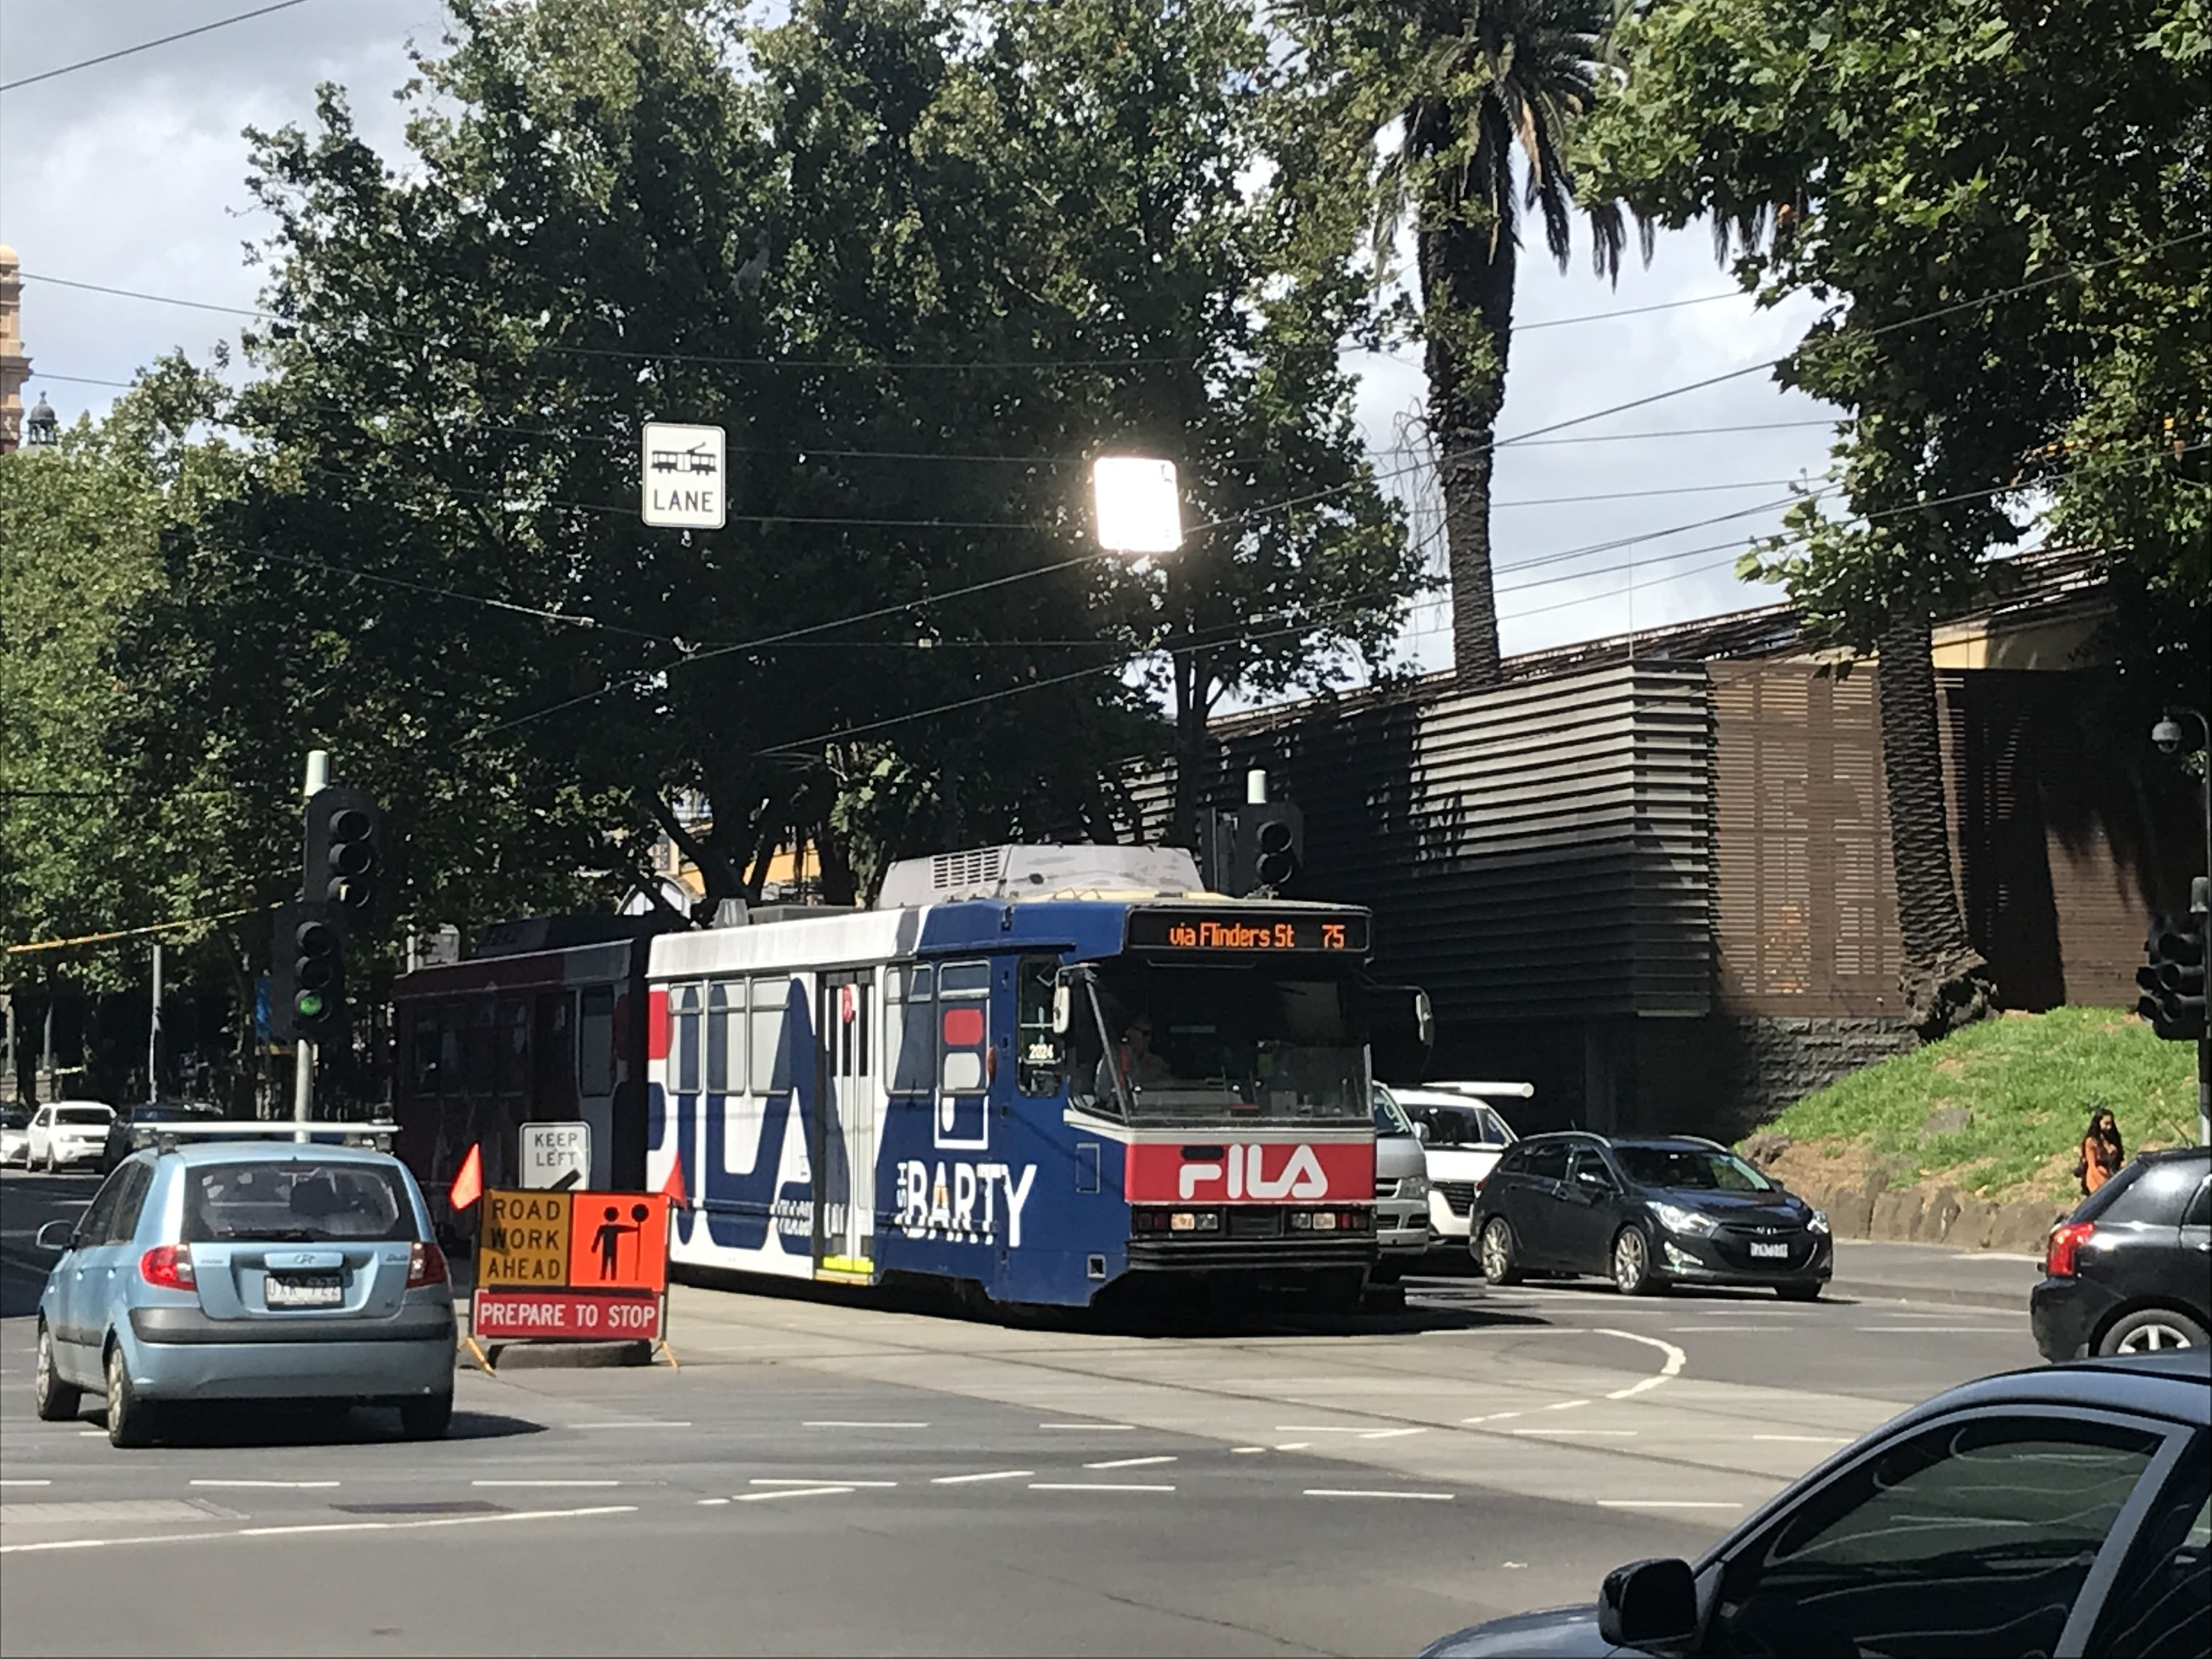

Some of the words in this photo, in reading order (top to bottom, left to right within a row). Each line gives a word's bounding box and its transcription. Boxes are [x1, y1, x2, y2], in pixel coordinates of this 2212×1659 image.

[653, 489, 714, 512] LANE
[1170, 922, 1197, 946] via
[1199, 922, 1271, 948] Flinders
[1274, 923, 1295, 948] St
[1321, 924, 1346, 949] 75
[535, 1132, 578, 1147] KEEP
[536, 1152, 576, 1167] LEFT
[1179, 1143, 1329, 1199] FILA
[492, 1199, 561, 1221] ROAD
[906, 1159, 1038, 1248] BARTY
[490, 1228, 560, 1251] WORK
[487, 1257, 560, 1280] AHEAD
[479, 1303, 565, 1327] PREPARE
[575, 1304, 599, 1327] TO
[608, 1304, 656, 1328] STOP
